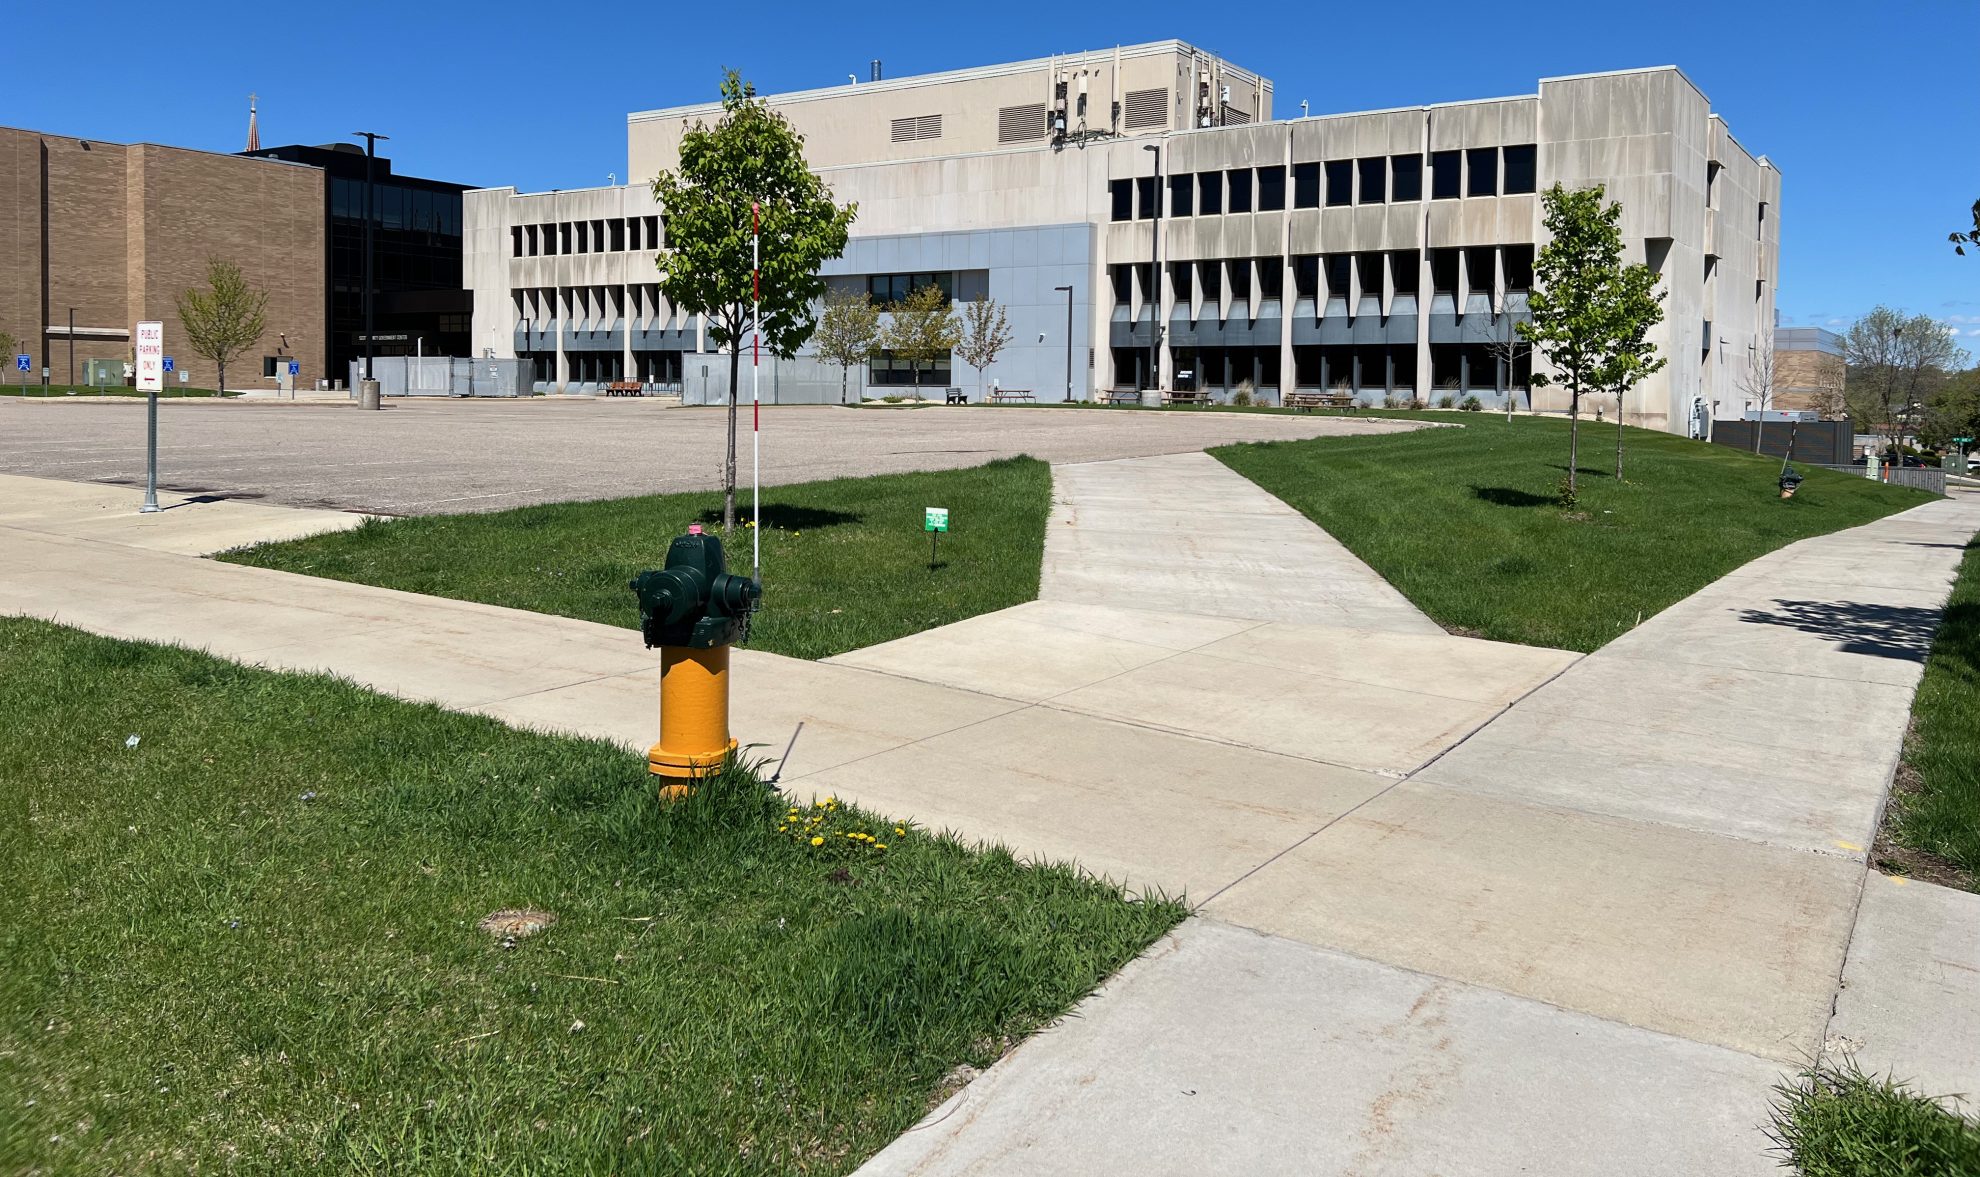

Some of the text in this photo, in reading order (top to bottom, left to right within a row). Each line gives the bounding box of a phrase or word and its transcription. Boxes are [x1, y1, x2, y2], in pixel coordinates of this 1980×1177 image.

[141, 330, 158, 339] PUBLIC
[139, 345, 160, 355] PARKING
[143, 361, 155, 370] ONLY
